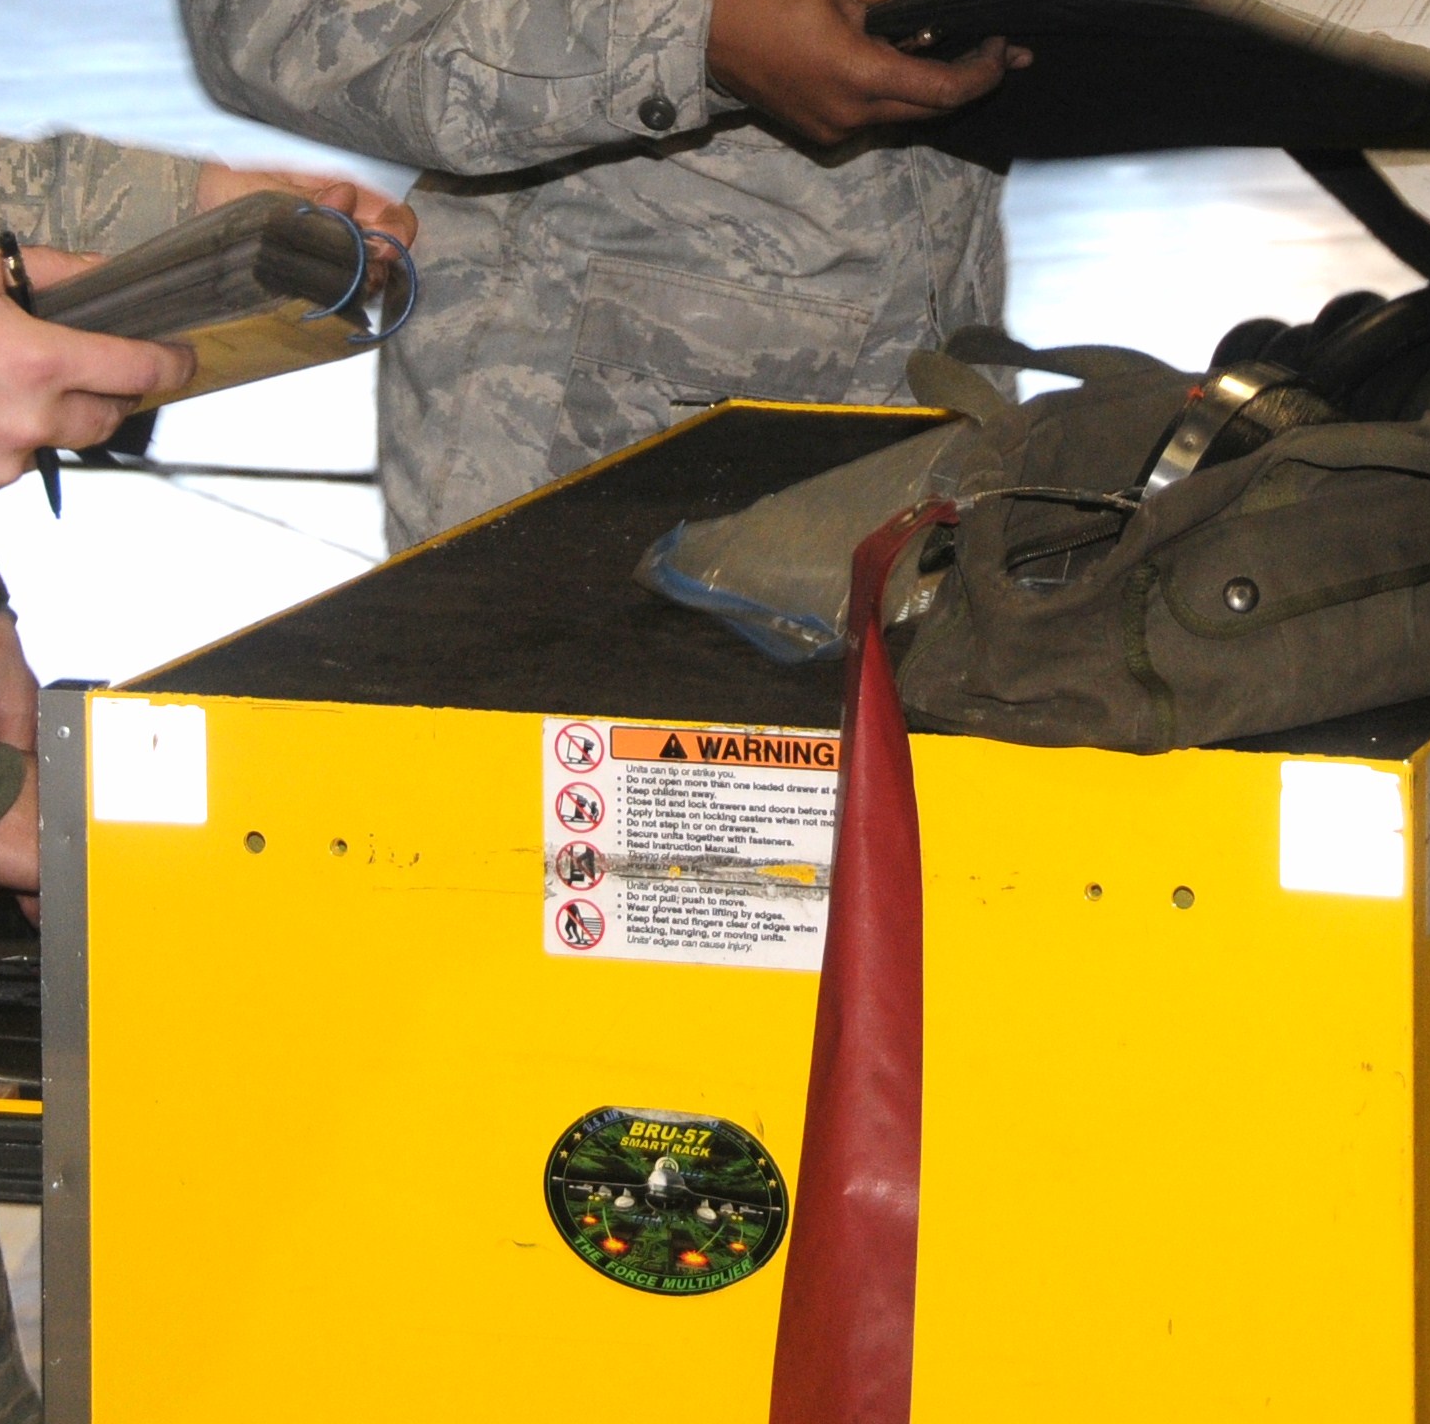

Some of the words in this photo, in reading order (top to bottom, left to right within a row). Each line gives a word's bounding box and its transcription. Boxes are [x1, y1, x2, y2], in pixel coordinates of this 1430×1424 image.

[696, 734, 835, 766] WARNING
[626, 764, 648, 774] Units
[668, 766, 679, 776] tip
[681, 768, 690, 776] or
[692, 768, 715, 777] strike
[627, 775, 639, 784] Do
[642, 776, 656, 784] not
[659, 779, 681, 787] open
[711, 780, 730, 788] than
[733, 782, 750, 790] one
[753, 782, 784, 791] loaded
[786, 784, 818, 793] drawer
[821, 786, 829, 794] at
[627, 786, 649, 796] Keep
[652, 787, 689, 796] children
[691, 790, 716, 800] away.
[627, 796, 652, 805] Close
[655, 798, 665, 806] lid
[668, 799, 685, 807] and
[688, 800, 707, 808] lock
[710, 801, 746, 811] drawers
[749, 804, 766, 812] and
[769, 804, 795, 814] doors
[798, 806, 827, 816] before
[627, 808, 652, 818] Apply
[656, 809, 686, 818] brakes
[703, 812, 736, 823] locking
[739, 815, 772, 823] casters
[775, 816, 799, 825] when
[803, 818, 817, 826] not
[627, 818, 639, 826] Do
[642, 820, 657, 828] not
[659, 821, 679, 831] step
[681, 821, 690, 830] in
[719, 824, 758, 833] drawers.
[627, 829, 658, 838] Secure
[661, 831, 683, 840] units
[687, 833, 724, 842] together
[727, 836, 746, 844] with
[749, 836, 794, 846] fasteners.
[627, 840, 649, 849] Read
[653, 841, 702, 852] Instruction
[704, 844, 740, 853] Manual.
[653, 883, 679, 893] edges
[681, 885, 697, 893] can
[699, 886, 712, 894] cut
[627, 892, 639, 900] Do
[682, 896, 705, 904] push
[708, 897, 717, 905] to
[719, 899, 747, 907] move.
[627, 903, 649, 911] Wear
[653, 905, 682, 914] gloves
[685, 907, 709, 915] when
[712, 908, 738, 919] lifting
[741, 910, 752, 919] by
[754, 910, 785, 921] edges.
[627, 914, 649, 924] Keep
[653, 914, 670, 924] feet
[672, 917, 689, 925] and
[691, 918, 723, 928] fingers
[726, 919, 748, 928] clear
[751, 921, 760, 929] of
[763, 922, 790, 932] edges
[793, 924, 818, 933] when
[627, 925, 668, 936] stacking,
[670, 927, 709, 938] hanging,
[712, 930, 722, 938] or
[724, 931, 758, 942] moving
[761, 932, 786, 942] units.
[653, 937, 679, 947] edges
[681, 939, 697, 947] can
[699, 940, 725, 948] cause
[583, 1117, 603, 1132] U.S.
[604, 1109, 620, 1123] AIR
[629, 1121, 712, 1145] BRU-57
[620, 1136, 669, 1152] SMART
[671, 1143, 711, 1157] RACK
[574, 1234, 603, 1262] THE
[604, 1260, 659, 1287] FORCE
[662, 1258, 753, 1290] MULTIPLIER
